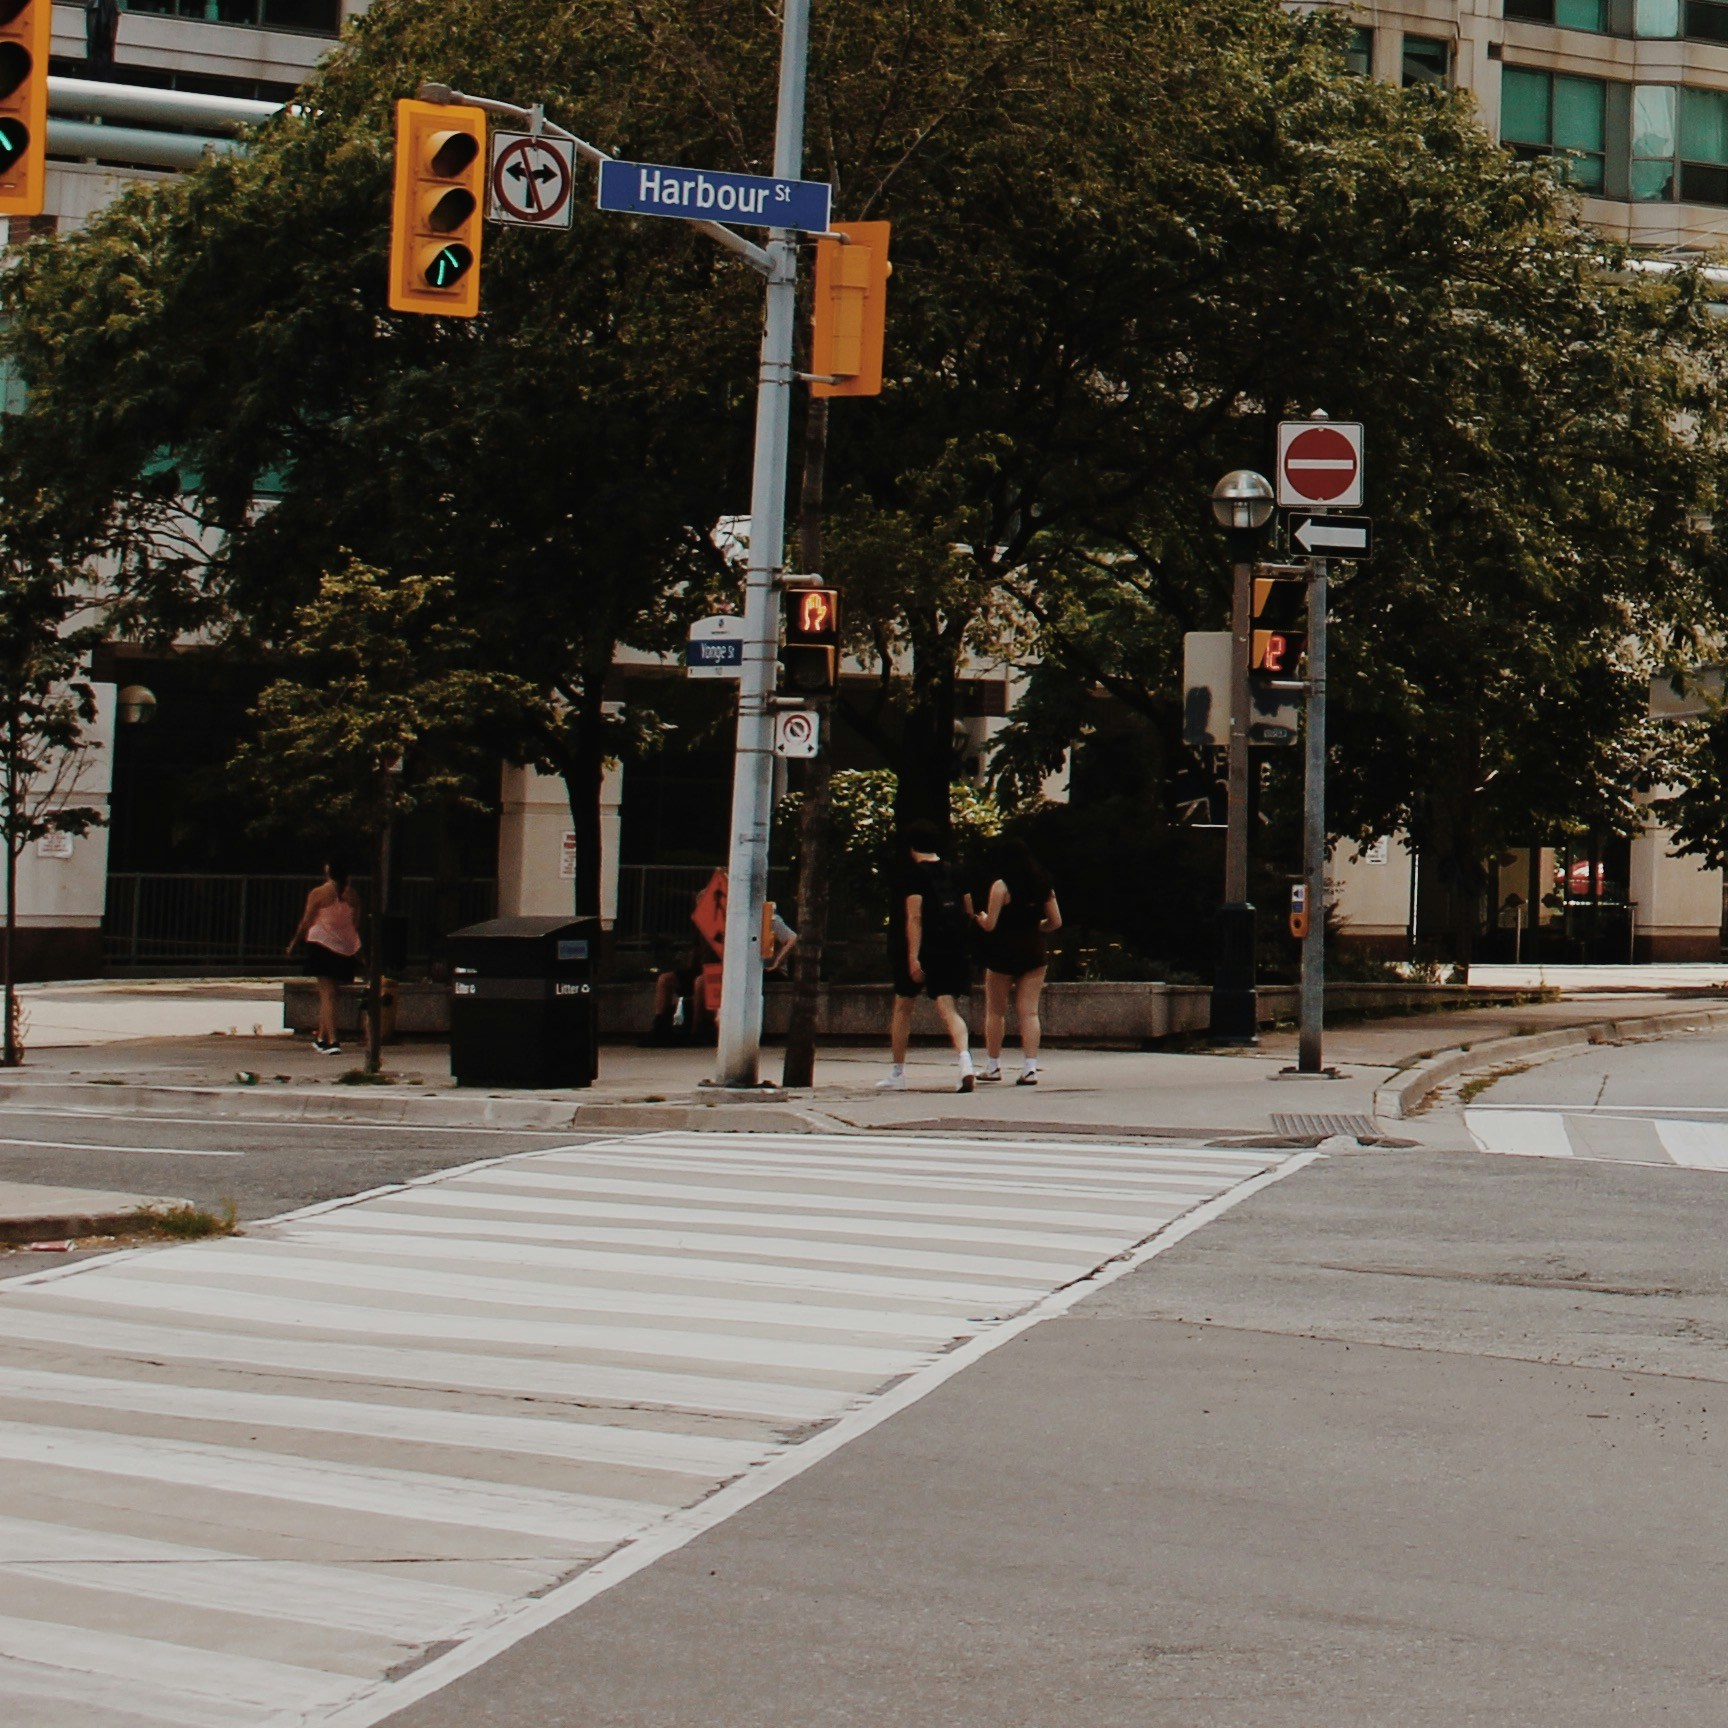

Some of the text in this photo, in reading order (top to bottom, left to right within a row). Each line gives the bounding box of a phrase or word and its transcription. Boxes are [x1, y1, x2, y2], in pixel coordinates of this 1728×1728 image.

[639, 168, 792, 214] Harbour St
[701, 642, 727, 664] Yonge
[556, 983, 579, 995] Litter
